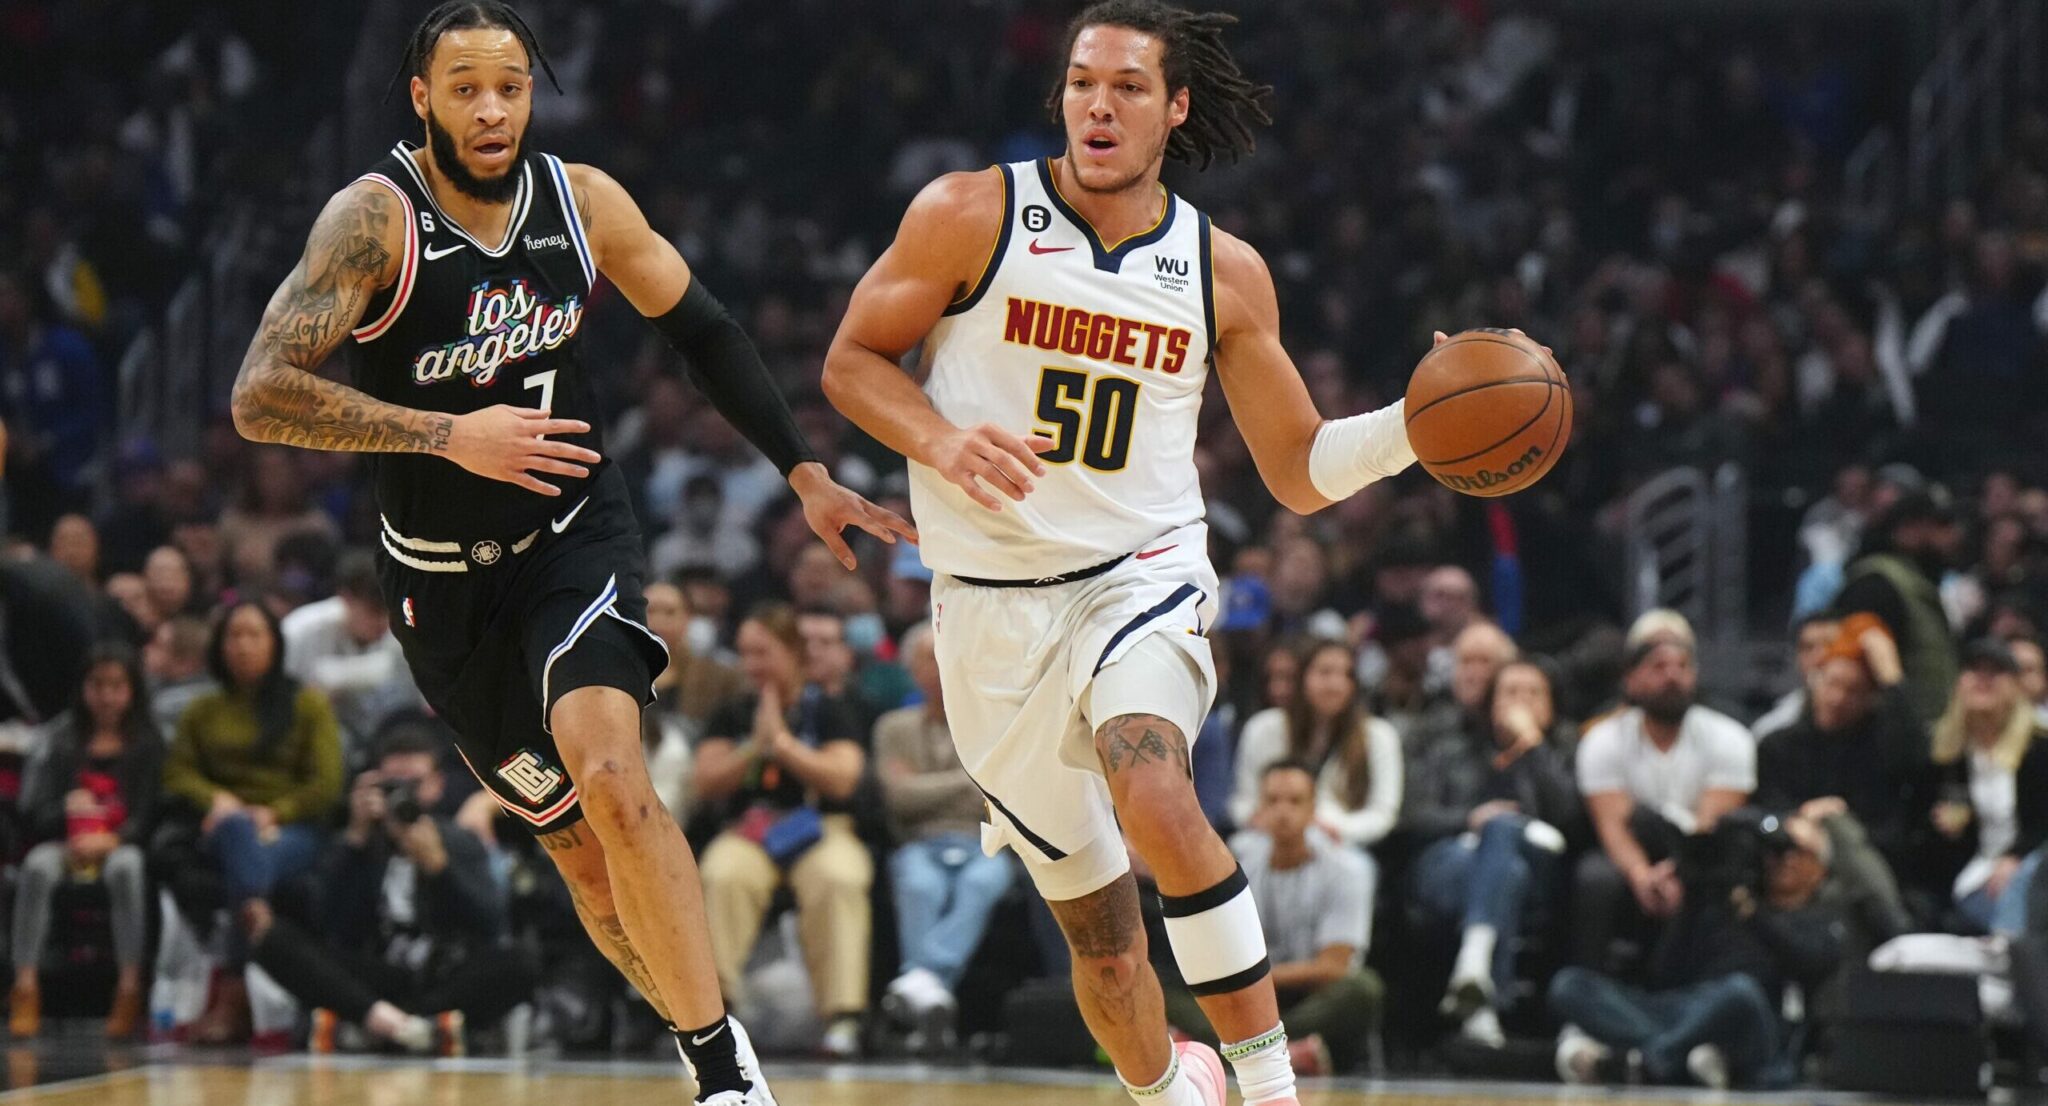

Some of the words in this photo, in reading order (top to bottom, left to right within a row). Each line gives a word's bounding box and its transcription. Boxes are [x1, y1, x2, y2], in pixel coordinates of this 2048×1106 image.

[420, 211, 435, 232] 6
[1027, 208, 1044, 230] 6
[523, 233, 570, 251] honey
[1154, 254, 1189, 277] WU
[1154, 273, 1189, 287] Western
[1160, 281, 1184, 293] Union
[467, 281, 537, 337] los
[413, 299, 582, 386] angeles
[1003, 295, 1192, 375] NUGGETS
[523, 368, 558, 441] 7
[1031, 365, 1142, 475] 50
[1438, 445, 1543, 491] Wilson
